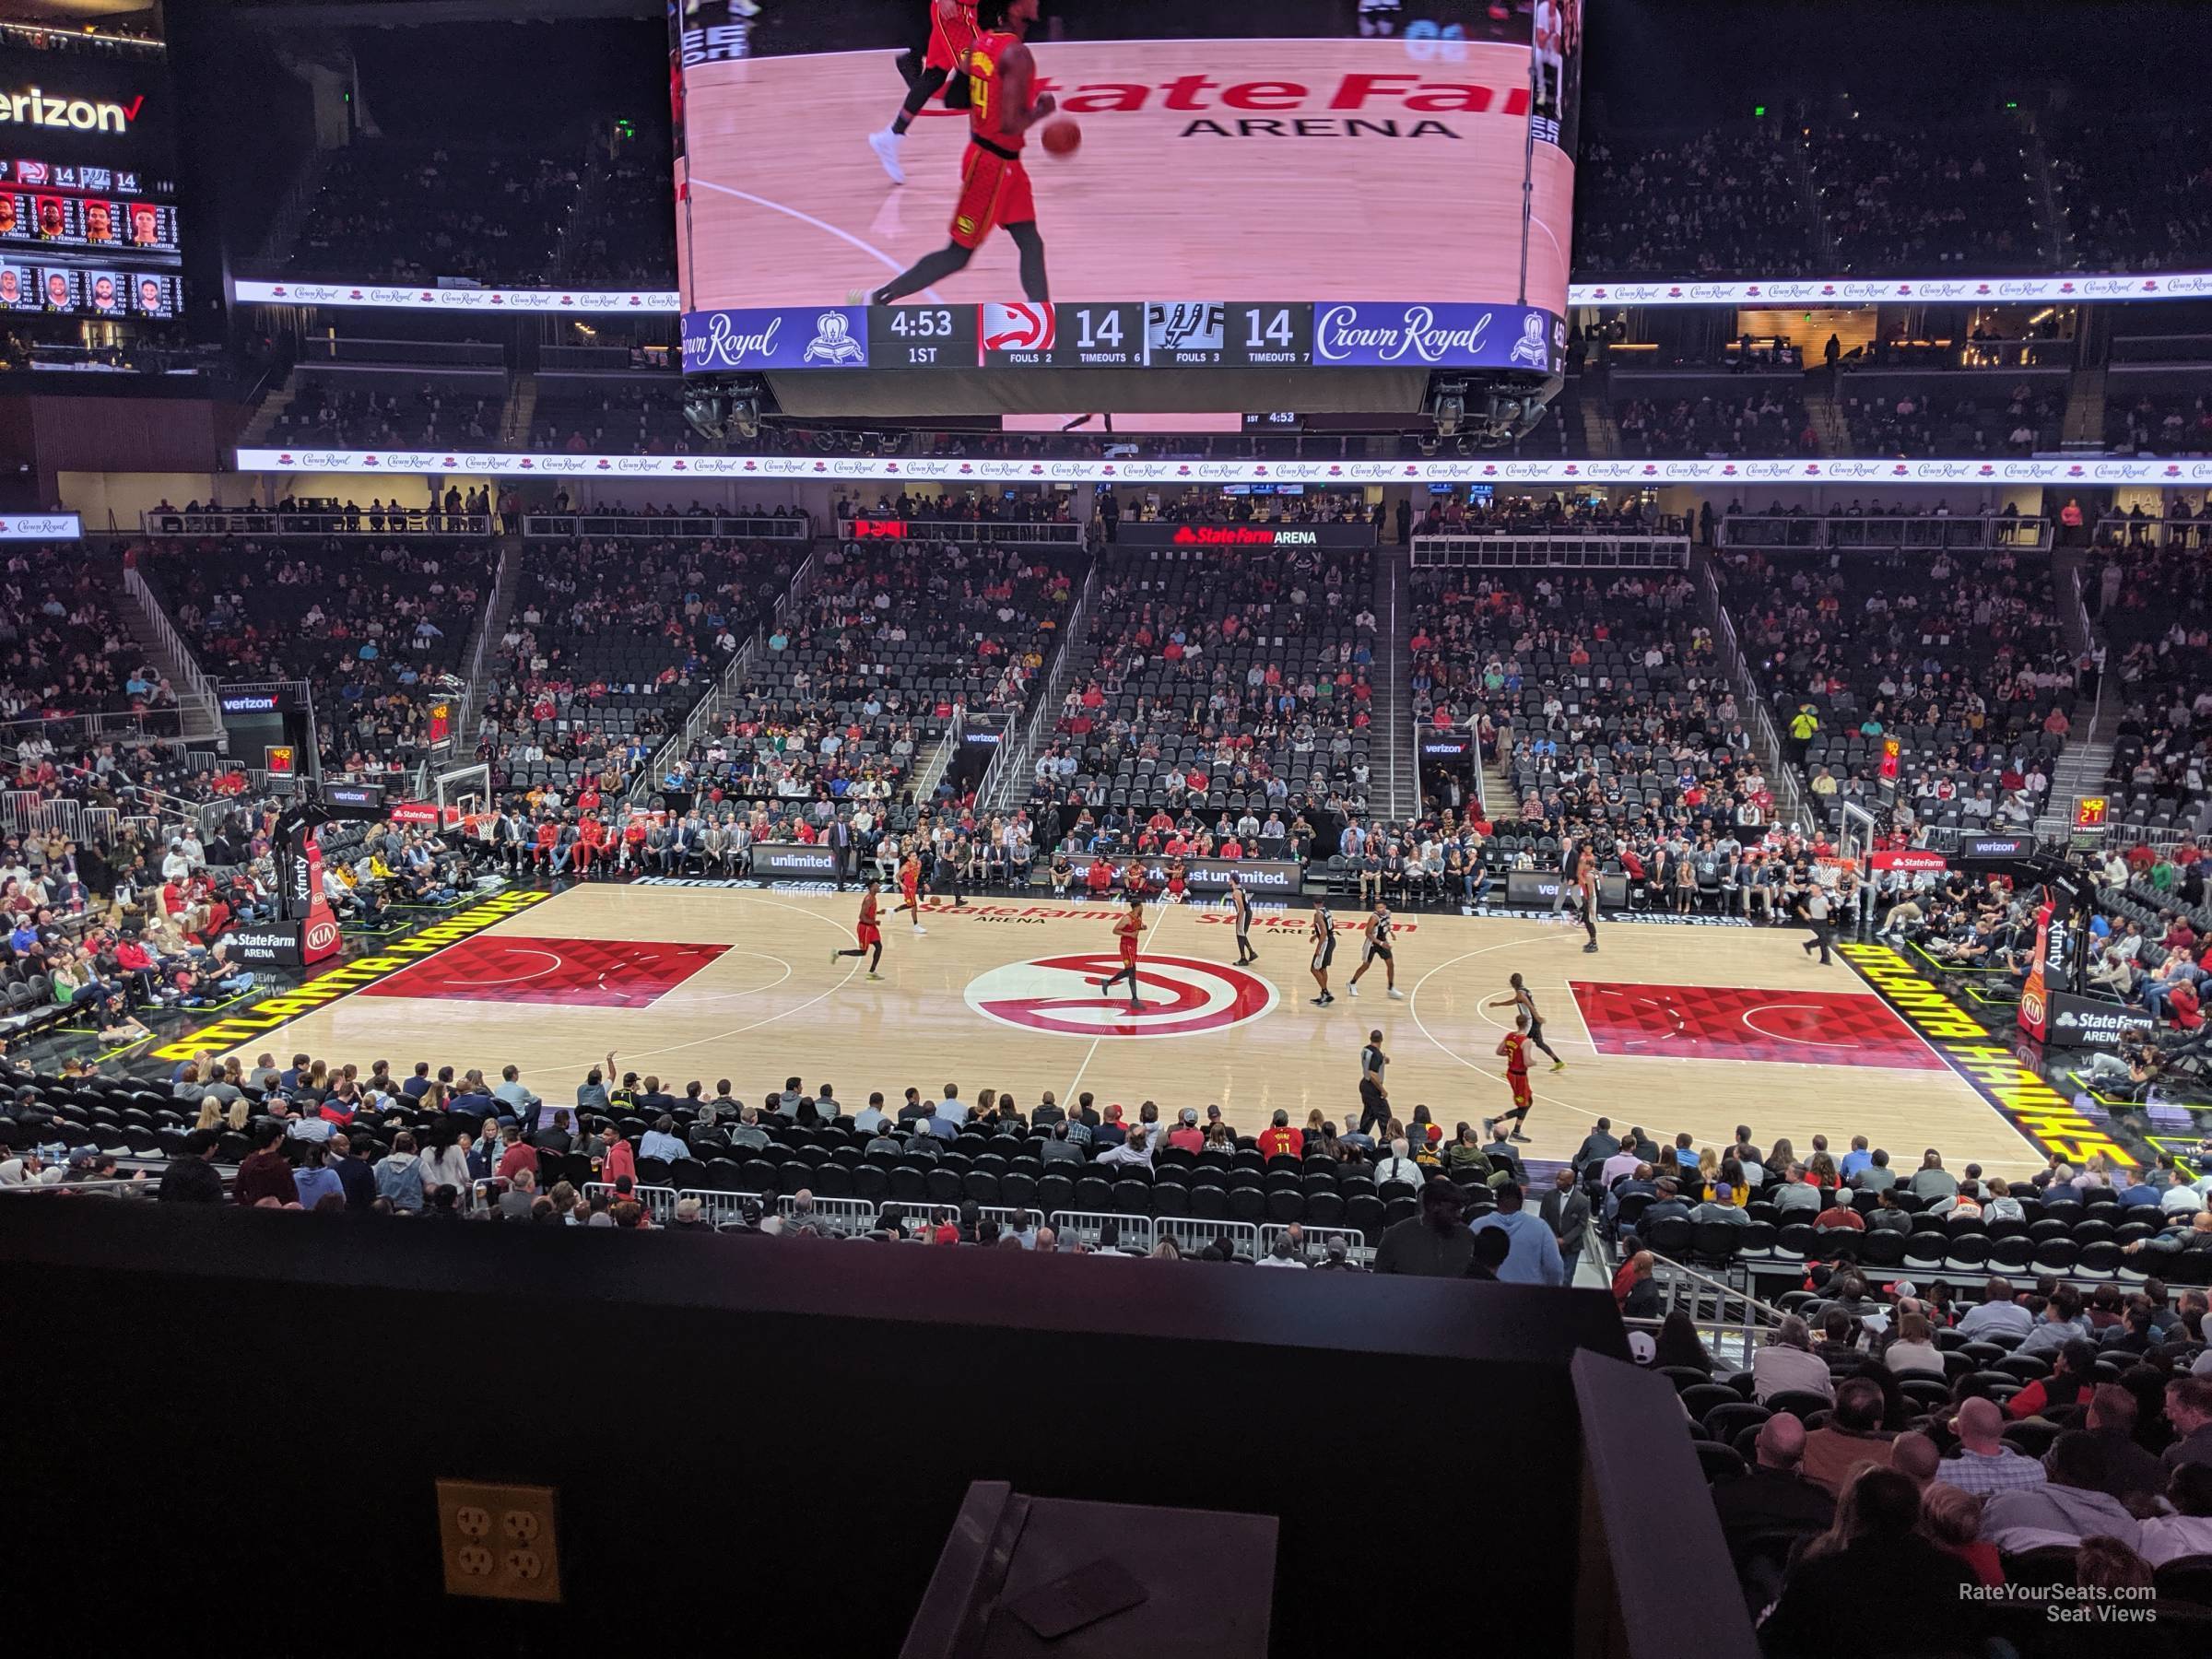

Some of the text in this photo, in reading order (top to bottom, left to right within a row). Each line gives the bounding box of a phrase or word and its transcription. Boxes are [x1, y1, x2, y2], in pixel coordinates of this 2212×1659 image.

[1180, 119, 1463, 139] ARENA
[55, 168, 74, 182] 14
[117, 173, 135, 187] 14
[890, 311, 952, 336] 4:53
[1077, 310, 1124, 347] 14
[1246, 310, 1293, 347] 14
[697, 313, 782, 366] Royal
[1317, 305, 1397, 360] Crown
[1379, 306, 1491, 361] Royal
[909, 347, 937, 363] 1ST
[1010, 353, 1052, 362] FOULS 2
[1080, 353, 1140, 362] TIMEOUTS 6
[1176, 353, 1219, 362] FOULS 3
[1249, 353, 1310, 362] TIMEOUTS 7
[1247, 412, 1295, 423] 1ST 4:53
[1274, 532, 1317, 544] ARENA
[224, 698, 273, 710] verizon
[967, 733, 999, 742] verizon
[1426, 744, 1461, 753] verizon
[335, 792, 365, 801] verizon
[2080, 810, 2099, 822] 21
[1976, 841, 2015, 852] verizon
[771, 854, 833, 868] unlimited
[295, 855, 311, 900] xfinity
[310, 925, 334, 947] KIA
[2046, 919, 2067, 971] xfinity
[244, 948, 275, 958] ARENA
[149, 890, 555, 1060] ATLANTA HAWKS
[2024, 998, 2042, 1022] KIA
[1838, 943, 2143, 1167] ATLANTA HAWKS
[1277, 1142, 1289, 1152] 11
